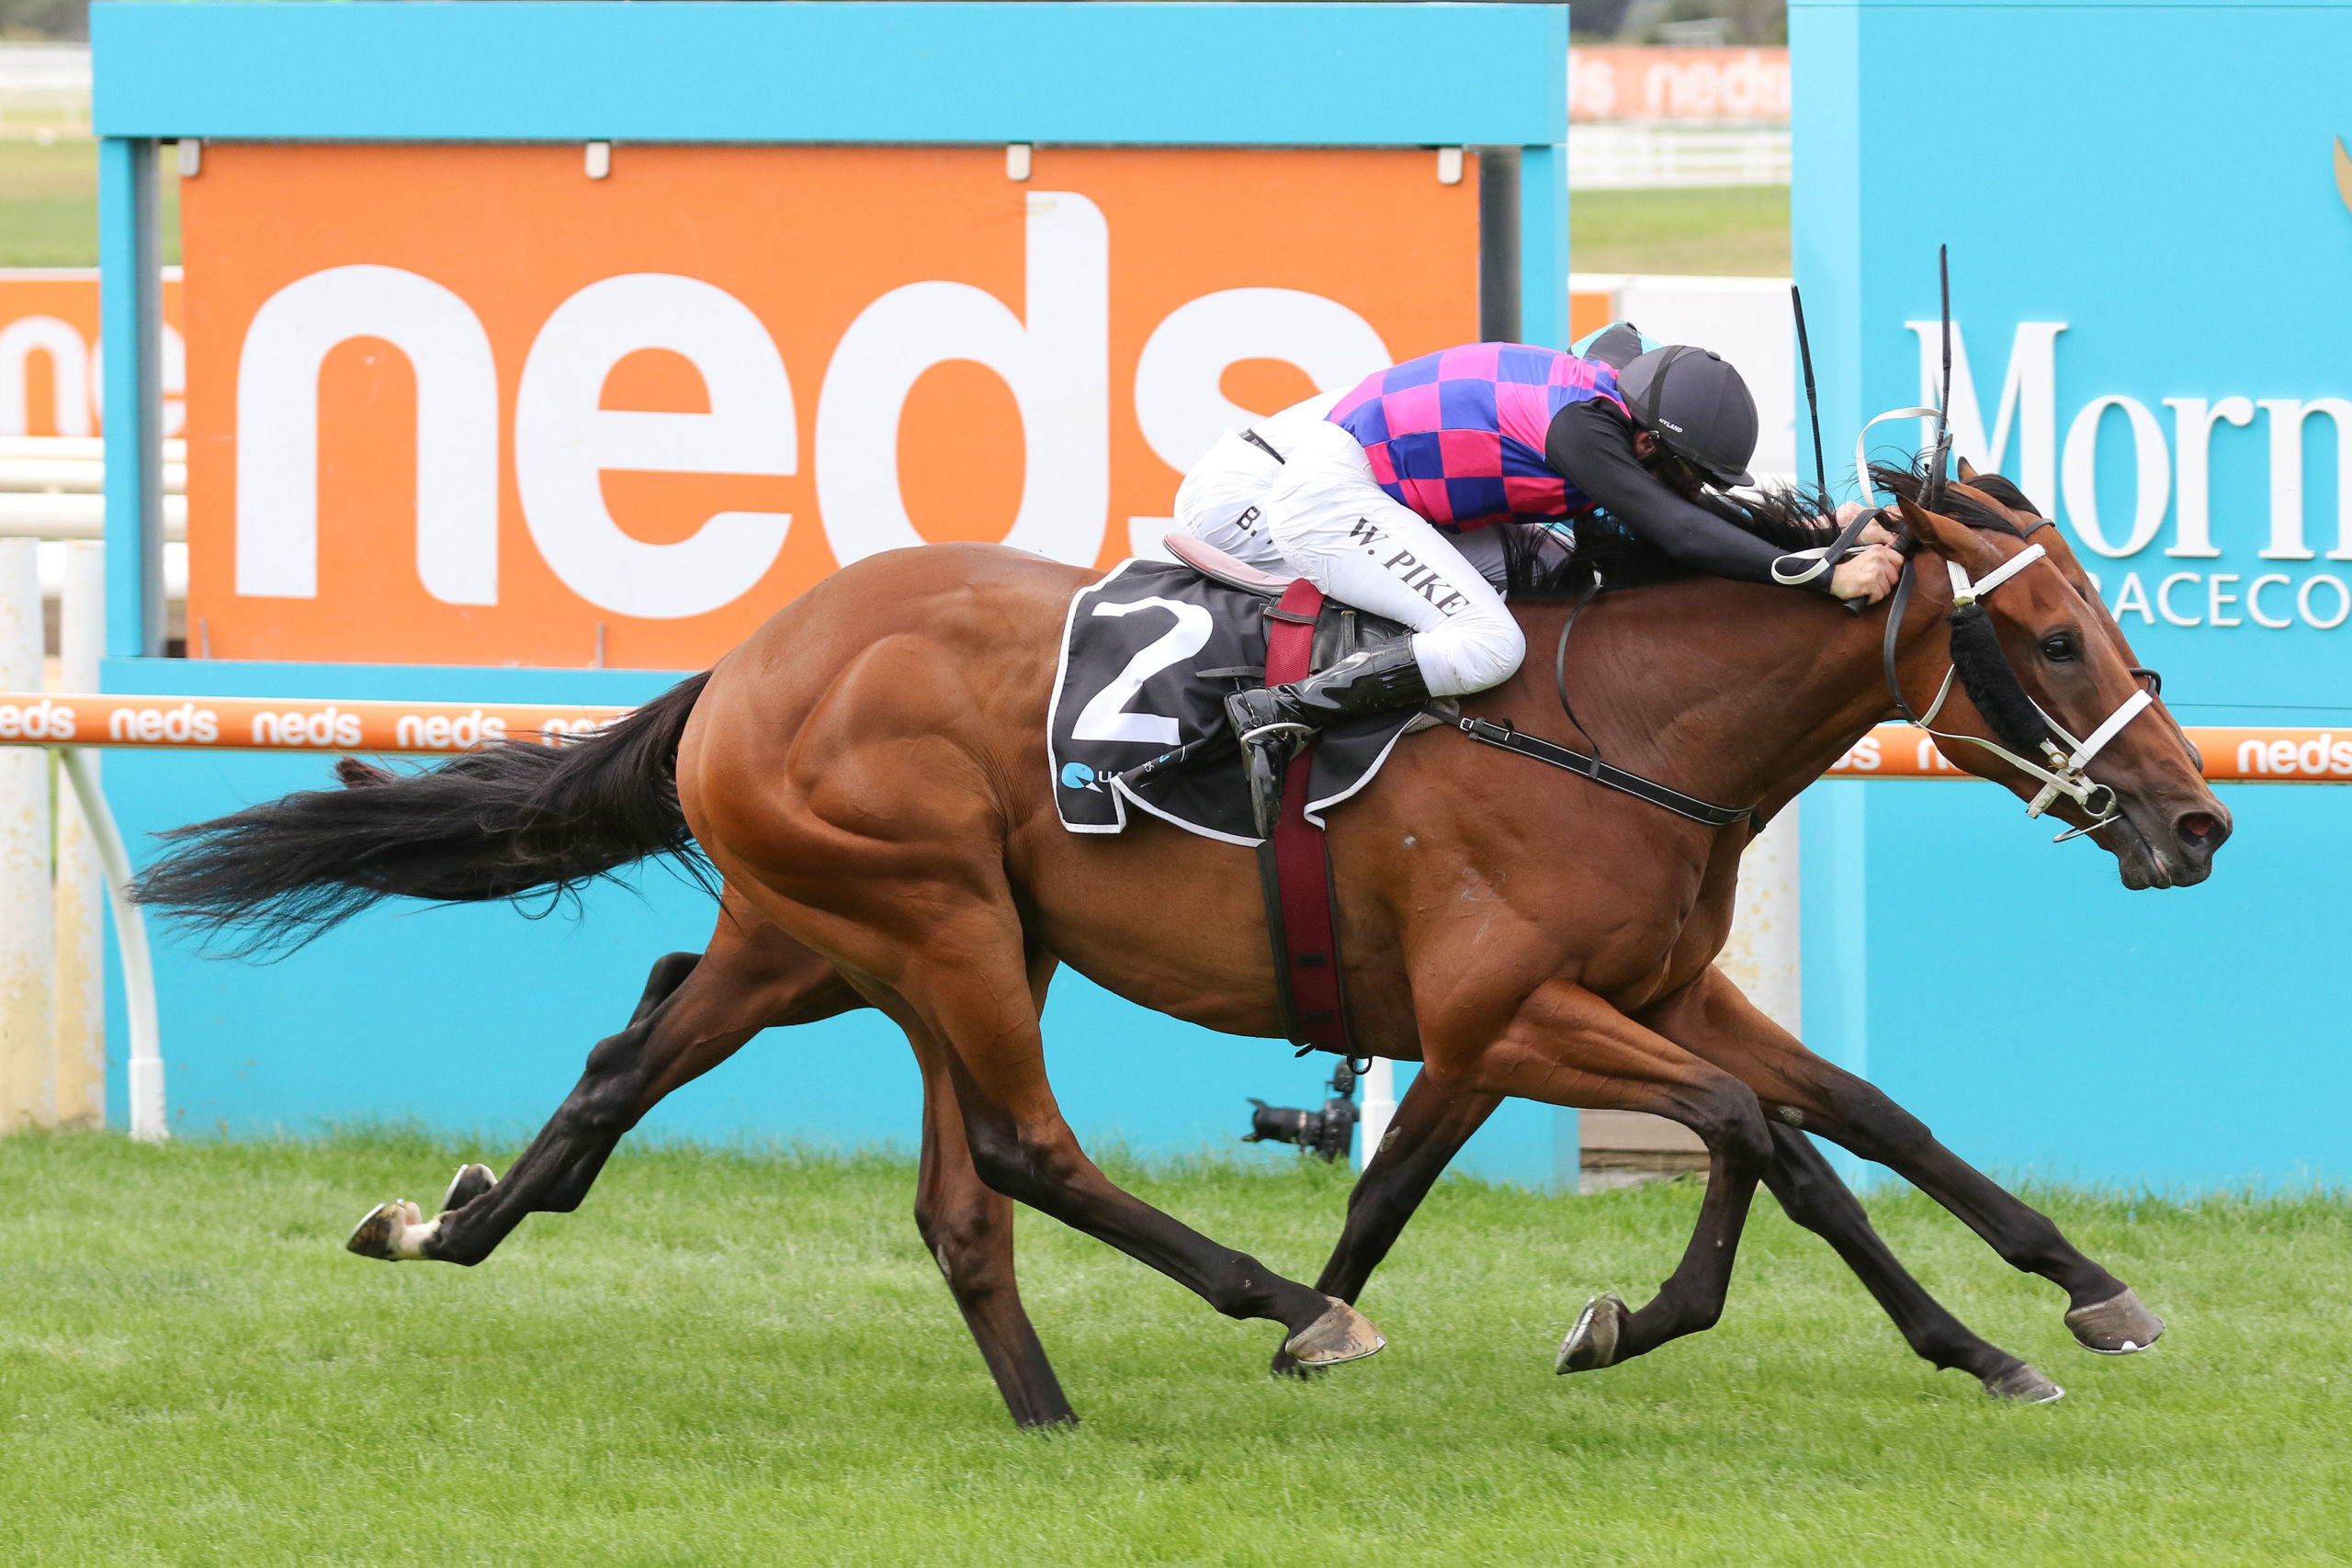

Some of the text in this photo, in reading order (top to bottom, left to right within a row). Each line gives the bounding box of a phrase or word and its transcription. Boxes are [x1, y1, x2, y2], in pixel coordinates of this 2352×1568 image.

[236, 191, 1394, 620] neds
[1905, 321, 2352, 559] Morn
[1350, 516, 1470, 617] W. PIKE
[108, 703, 219, 742] neds
[252, 706, 362, 746] neds
[396, 709, 507, 749] neds
[1071, 596, 1214, 746] 2
[2237, 733, 2352, 774] neds
